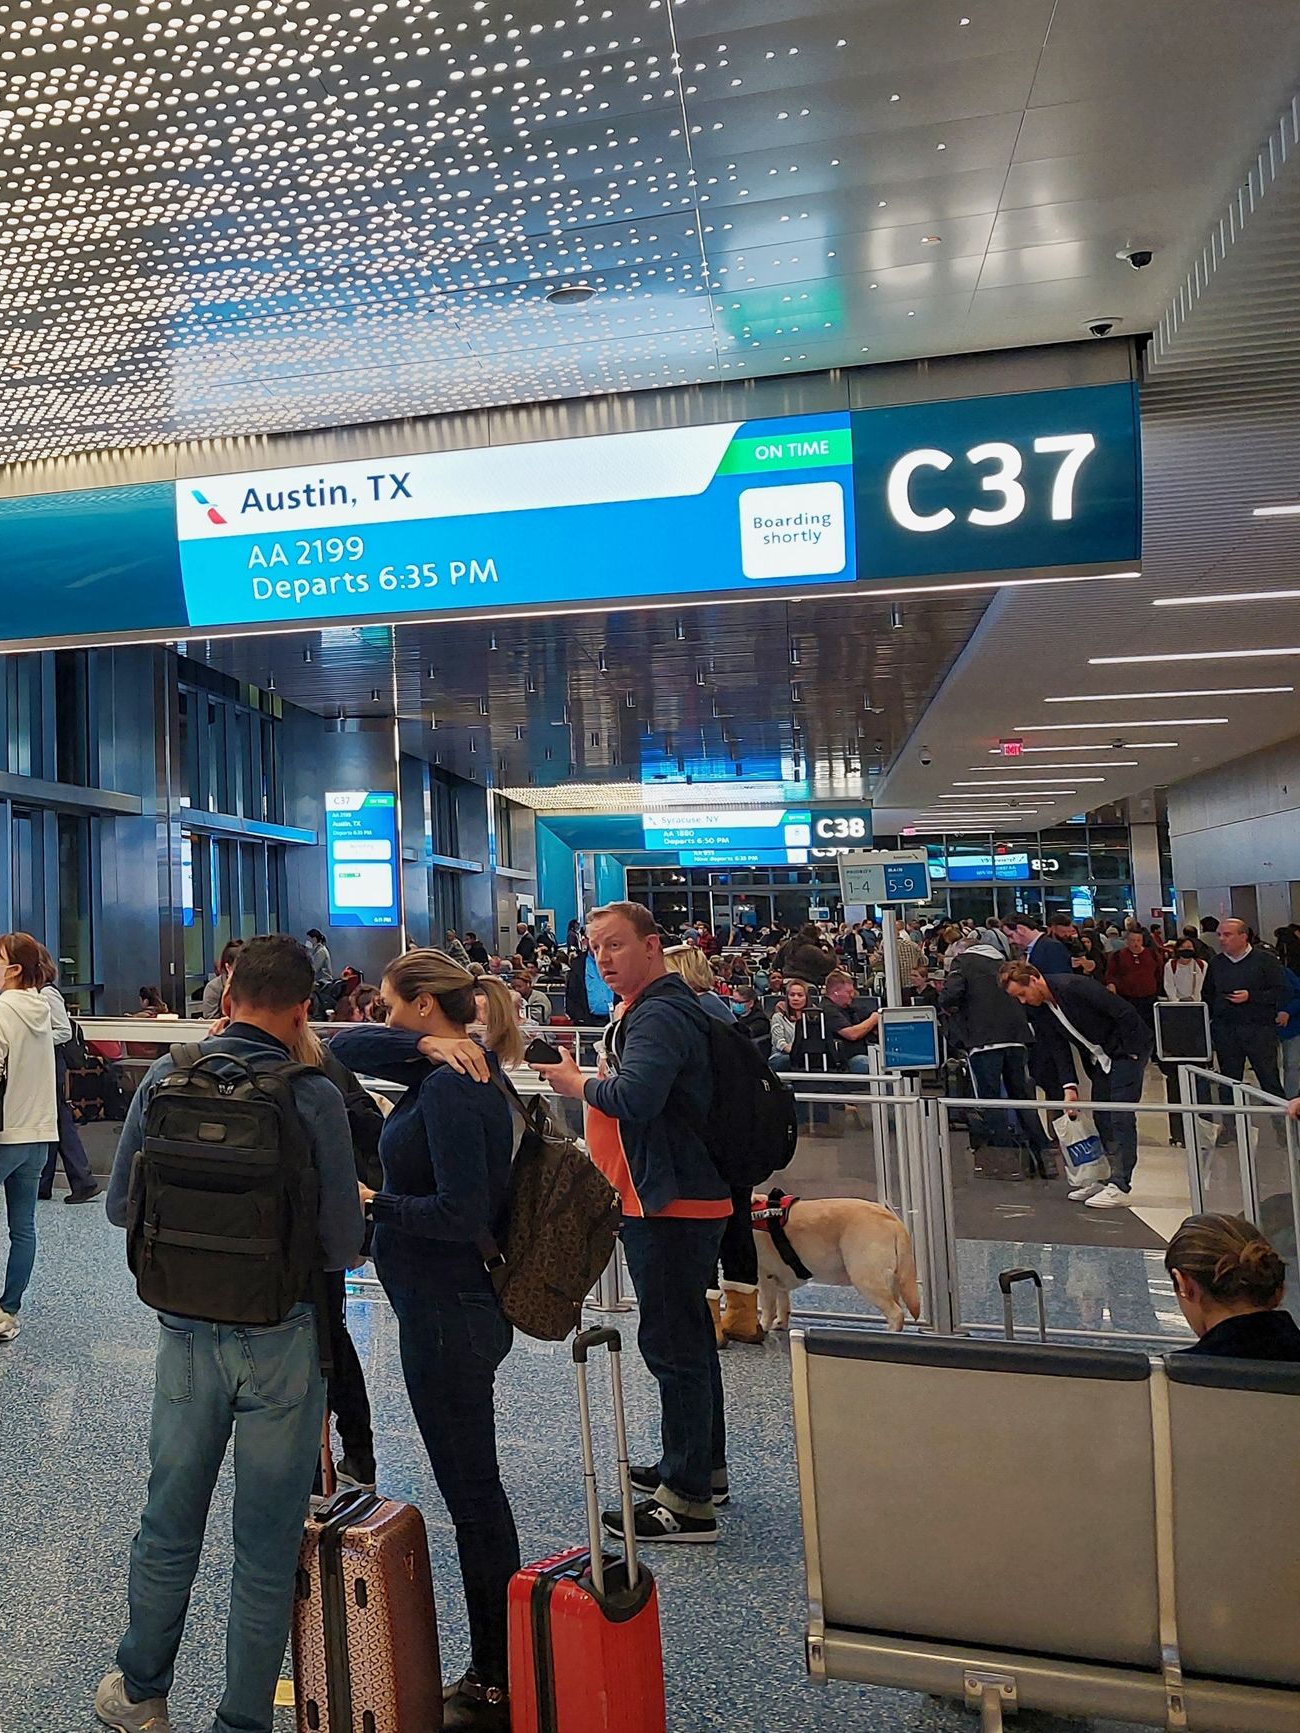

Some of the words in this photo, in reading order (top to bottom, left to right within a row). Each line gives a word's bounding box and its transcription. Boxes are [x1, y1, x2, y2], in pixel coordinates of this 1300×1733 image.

[755, 444, 784, 460] ON
[787, 440, 829, 457] TIME
[241, 479, 357, 513] Austin,
[367, 472, 412, 501] TX
[887, 433, 1096, 532] C37
[753, 513, 832, 529] Boarding
[763, 529, 822, 545] shortly
[248, 543, 289, 569] AA
[295, 536, 364, 565] 2199
[252, 571, 370, 603] Departs
[378, 563, 439, 590] 6:35
[449, 558, 499, 585] PM
[817, 818, 865, 838] C38
[849, 881, 870, 893] 1-4
[889, 879, 913, 892] 5-9
